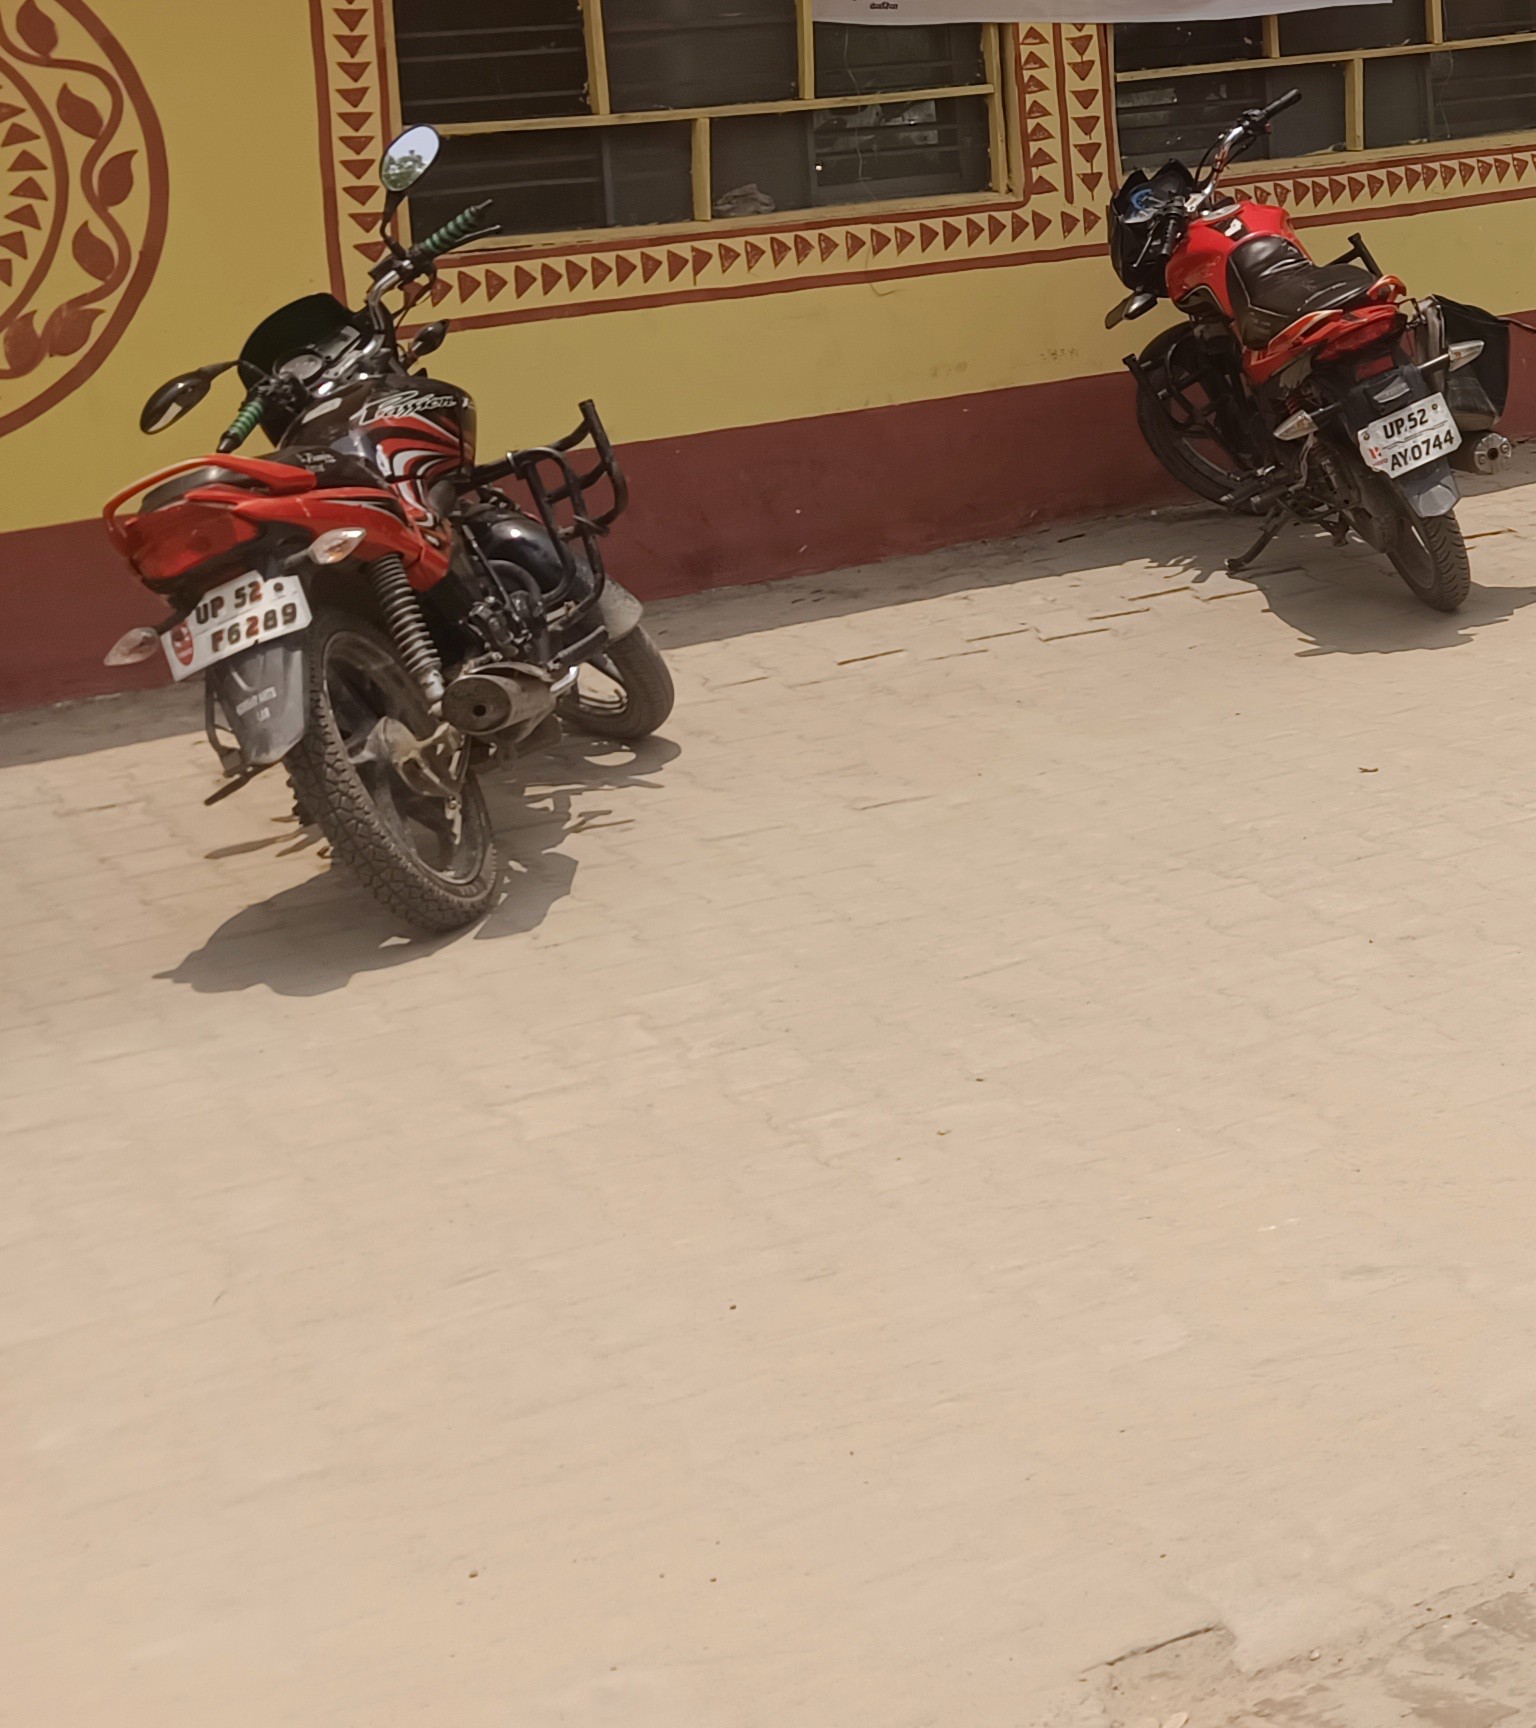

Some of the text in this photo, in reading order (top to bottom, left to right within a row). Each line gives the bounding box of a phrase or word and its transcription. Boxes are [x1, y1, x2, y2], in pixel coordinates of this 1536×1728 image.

[349, 390, 457, 426] Passion
[196, 580, 263, 624] UP 52
[211, 602, 297, 653] F6289
